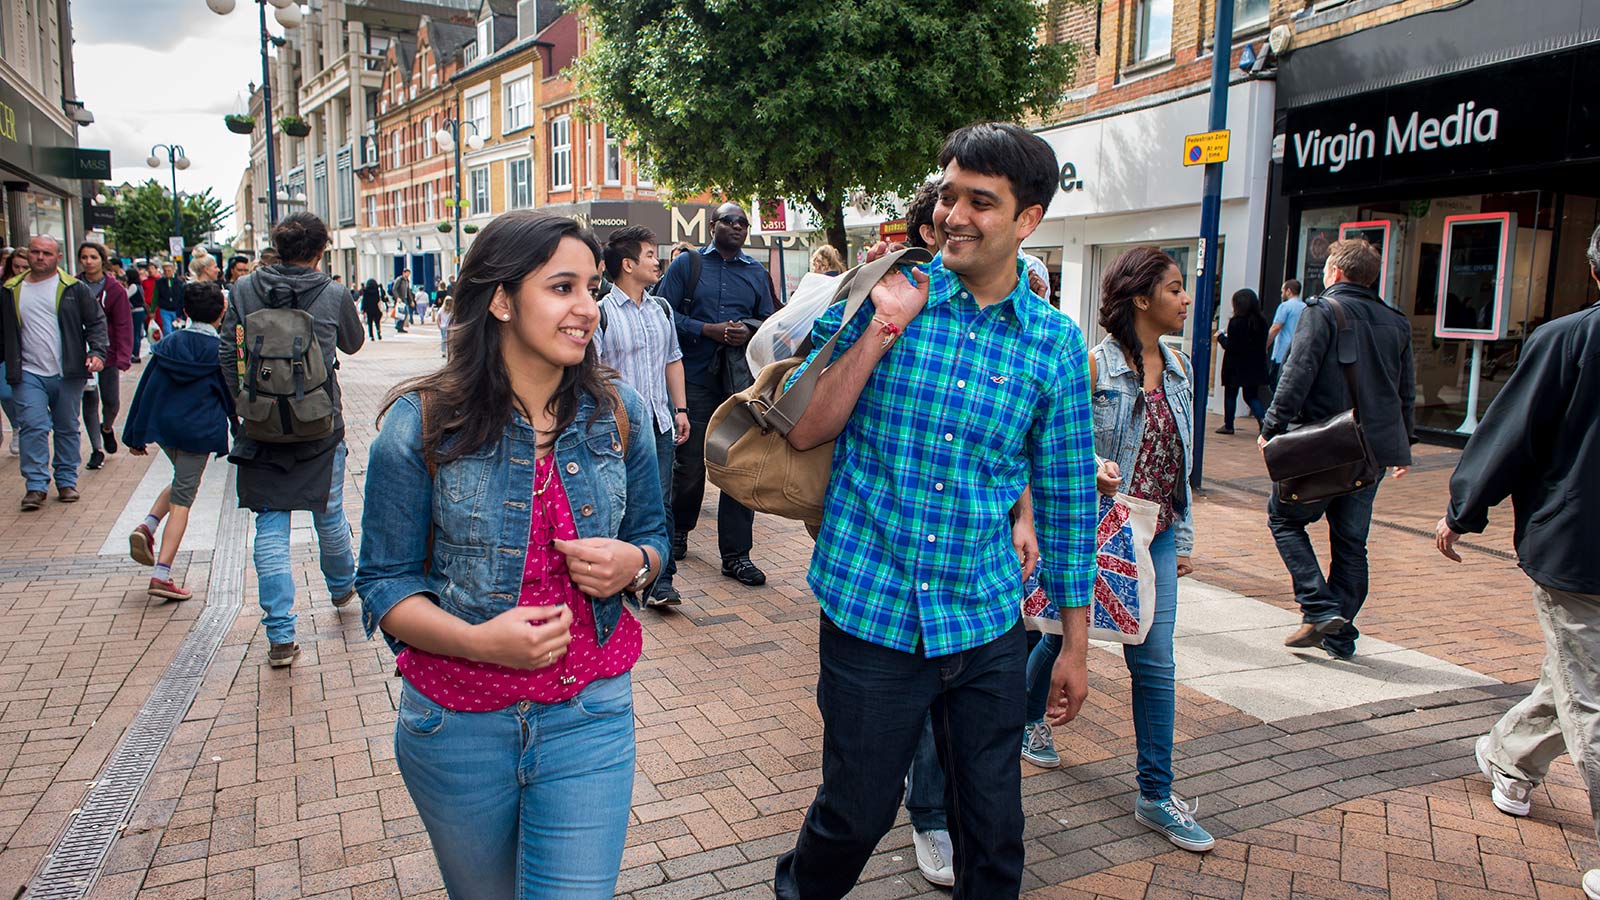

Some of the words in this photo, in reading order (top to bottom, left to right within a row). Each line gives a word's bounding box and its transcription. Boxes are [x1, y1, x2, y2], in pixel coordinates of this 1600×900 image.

[1187, 135, 1214, 143] Pedestrian
[1293, 122, 1376, 173] Virgin
[1384, 100, 1499, 156] Media
[80, 159, 107, 170] M&S
[590, 218, 627, 226] MONSOON
